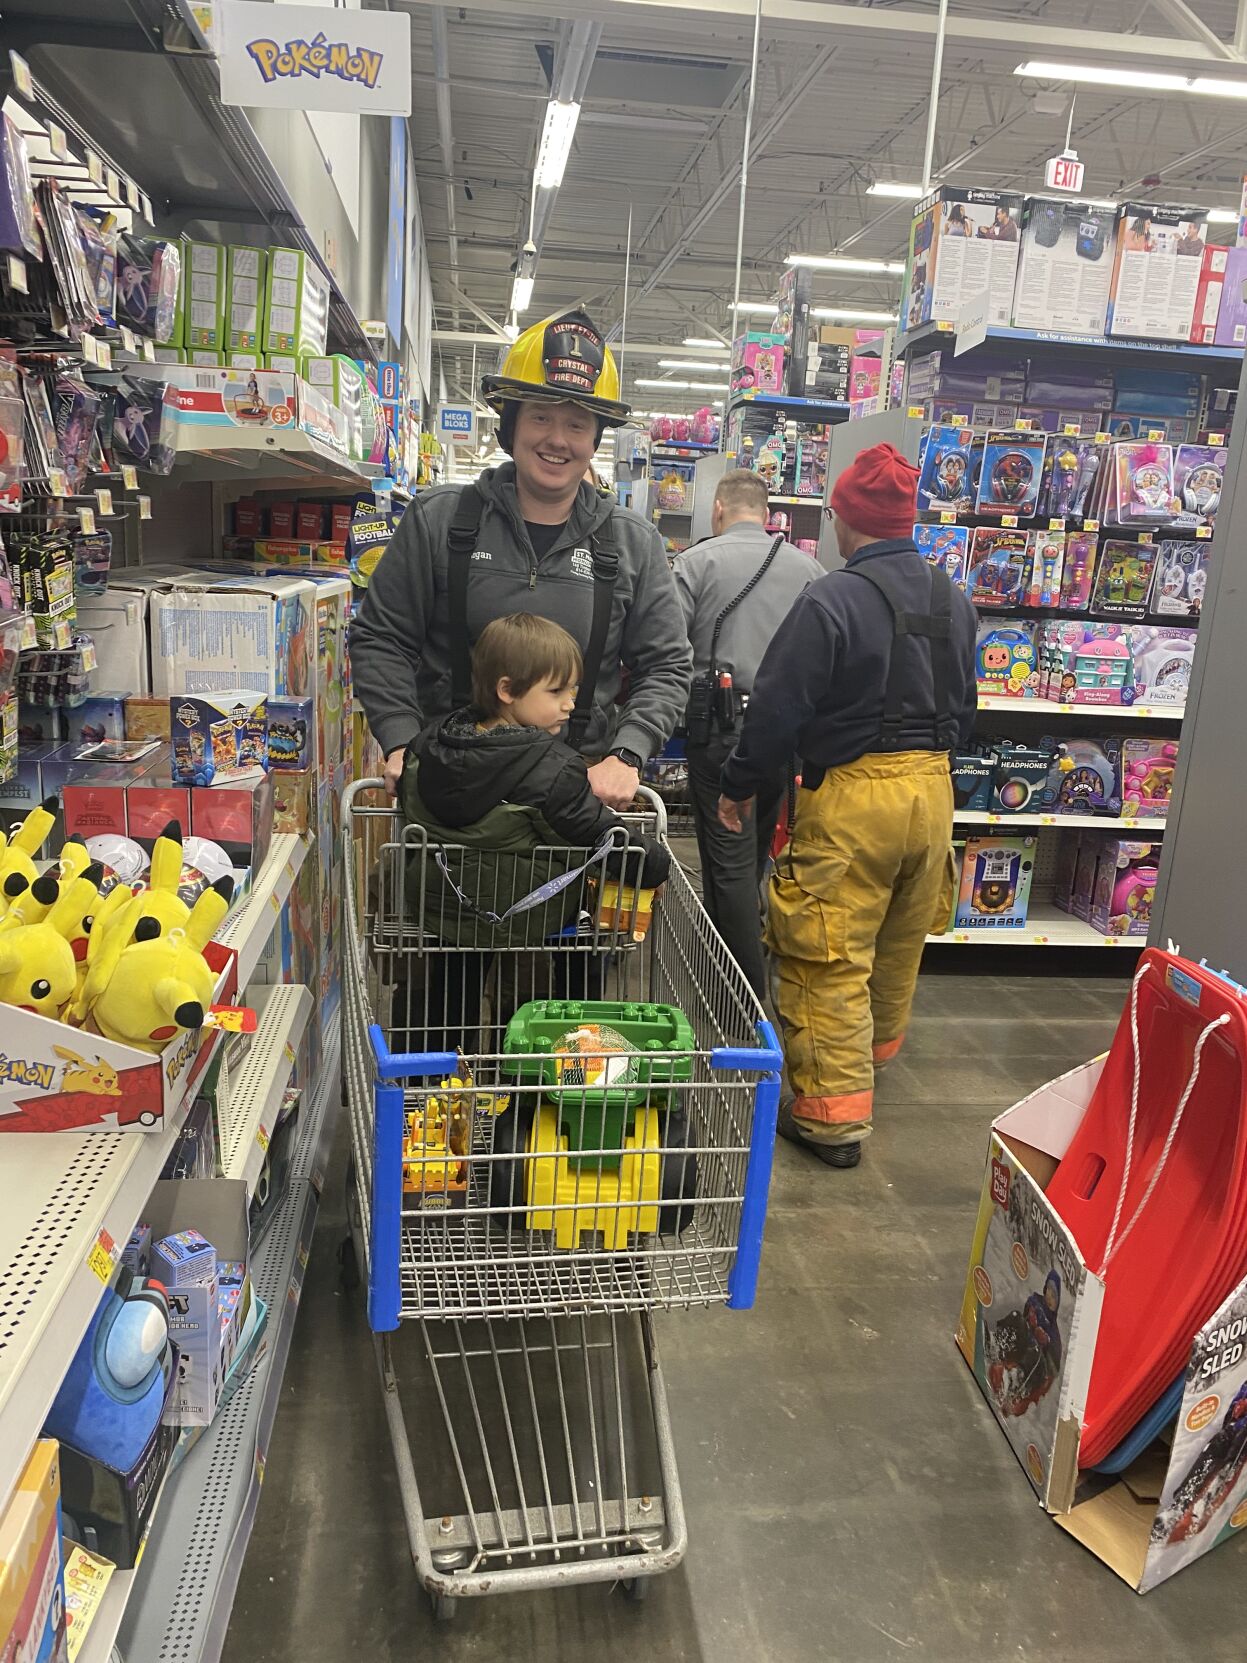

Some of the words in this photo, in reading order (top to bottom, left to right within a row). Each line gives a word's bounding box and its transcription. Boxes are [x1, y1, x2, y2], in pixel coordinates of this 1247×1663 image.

[1053, 161, 1081, 188] EXIT
[570, 334, 582, 356] 1
[1060, 335, 1093, 343] assistance
[558, 359, 589, 374] CRYSTAL
[554, 373, 571, 381] FIRE
[572, 375, 589, 387] DEPT
[274, 411, 289, 423] 3+
[444, 412, 468, 421] MEGA
[444, 420, 469, 429] BLOKS
[353, 522, 385, 533] LIGHT-UP
[1001, 761, 1048, 769] HEADPHONES
[0, 790, 30, 799] EMPEST
[993, 1166, 1008, 1188] Play
[993, 1179, 1007, 1200] Day
[1031, 1202, 1058, 1247] SNOW
[1057, 1241, 1076, 1287] SLED
[1201, 1343, 1243, 1379] SLED
